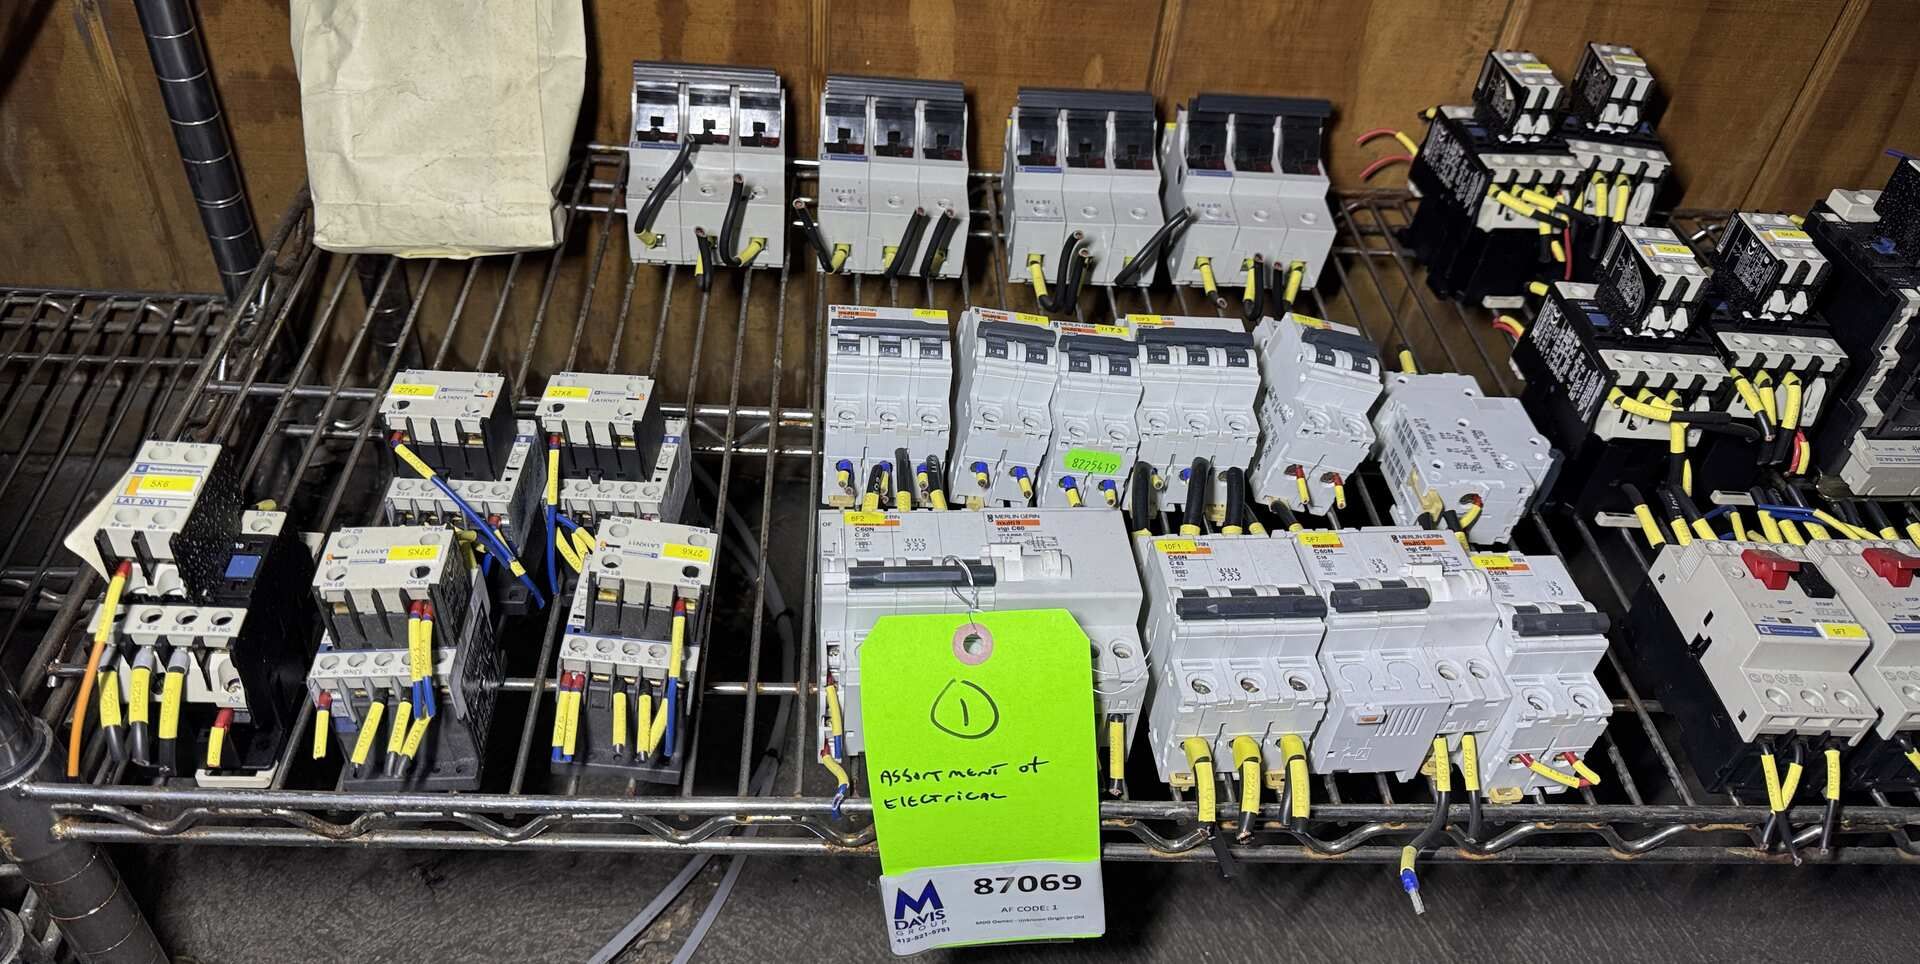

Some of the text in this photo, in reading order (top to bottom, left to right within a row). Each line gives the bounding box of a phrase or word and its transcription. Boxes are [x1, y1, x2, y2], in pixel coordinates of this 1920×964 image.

[973, 874, 1082, 896] 87069
[894, 879, 944, 920] M
[1016, 904, 1050, 913] CODE:
[894, 910, 946, 931] DAVIS
